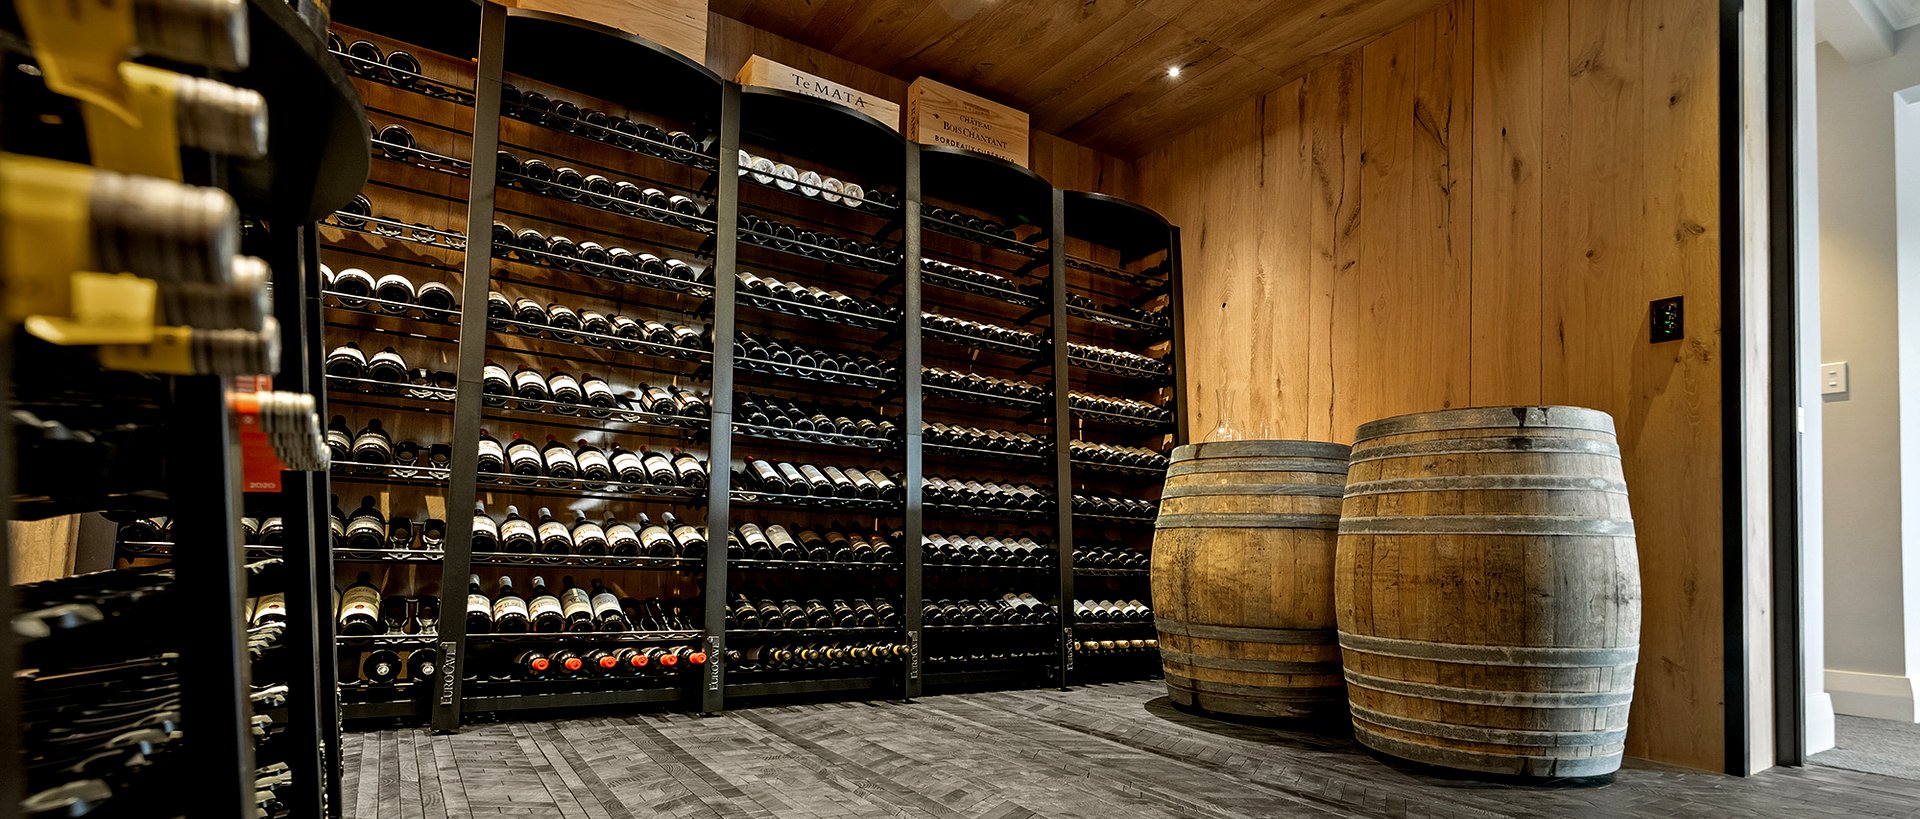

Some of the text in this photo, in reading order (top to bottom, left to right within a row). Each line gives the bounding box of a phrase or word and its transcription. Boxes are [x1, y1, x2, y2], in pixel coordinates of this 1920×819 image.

[792, 74, 810, 89] Te
[814, 82, 865, 107] MATA
[943, 121, 1008, 149] BOIS CHANTANT
